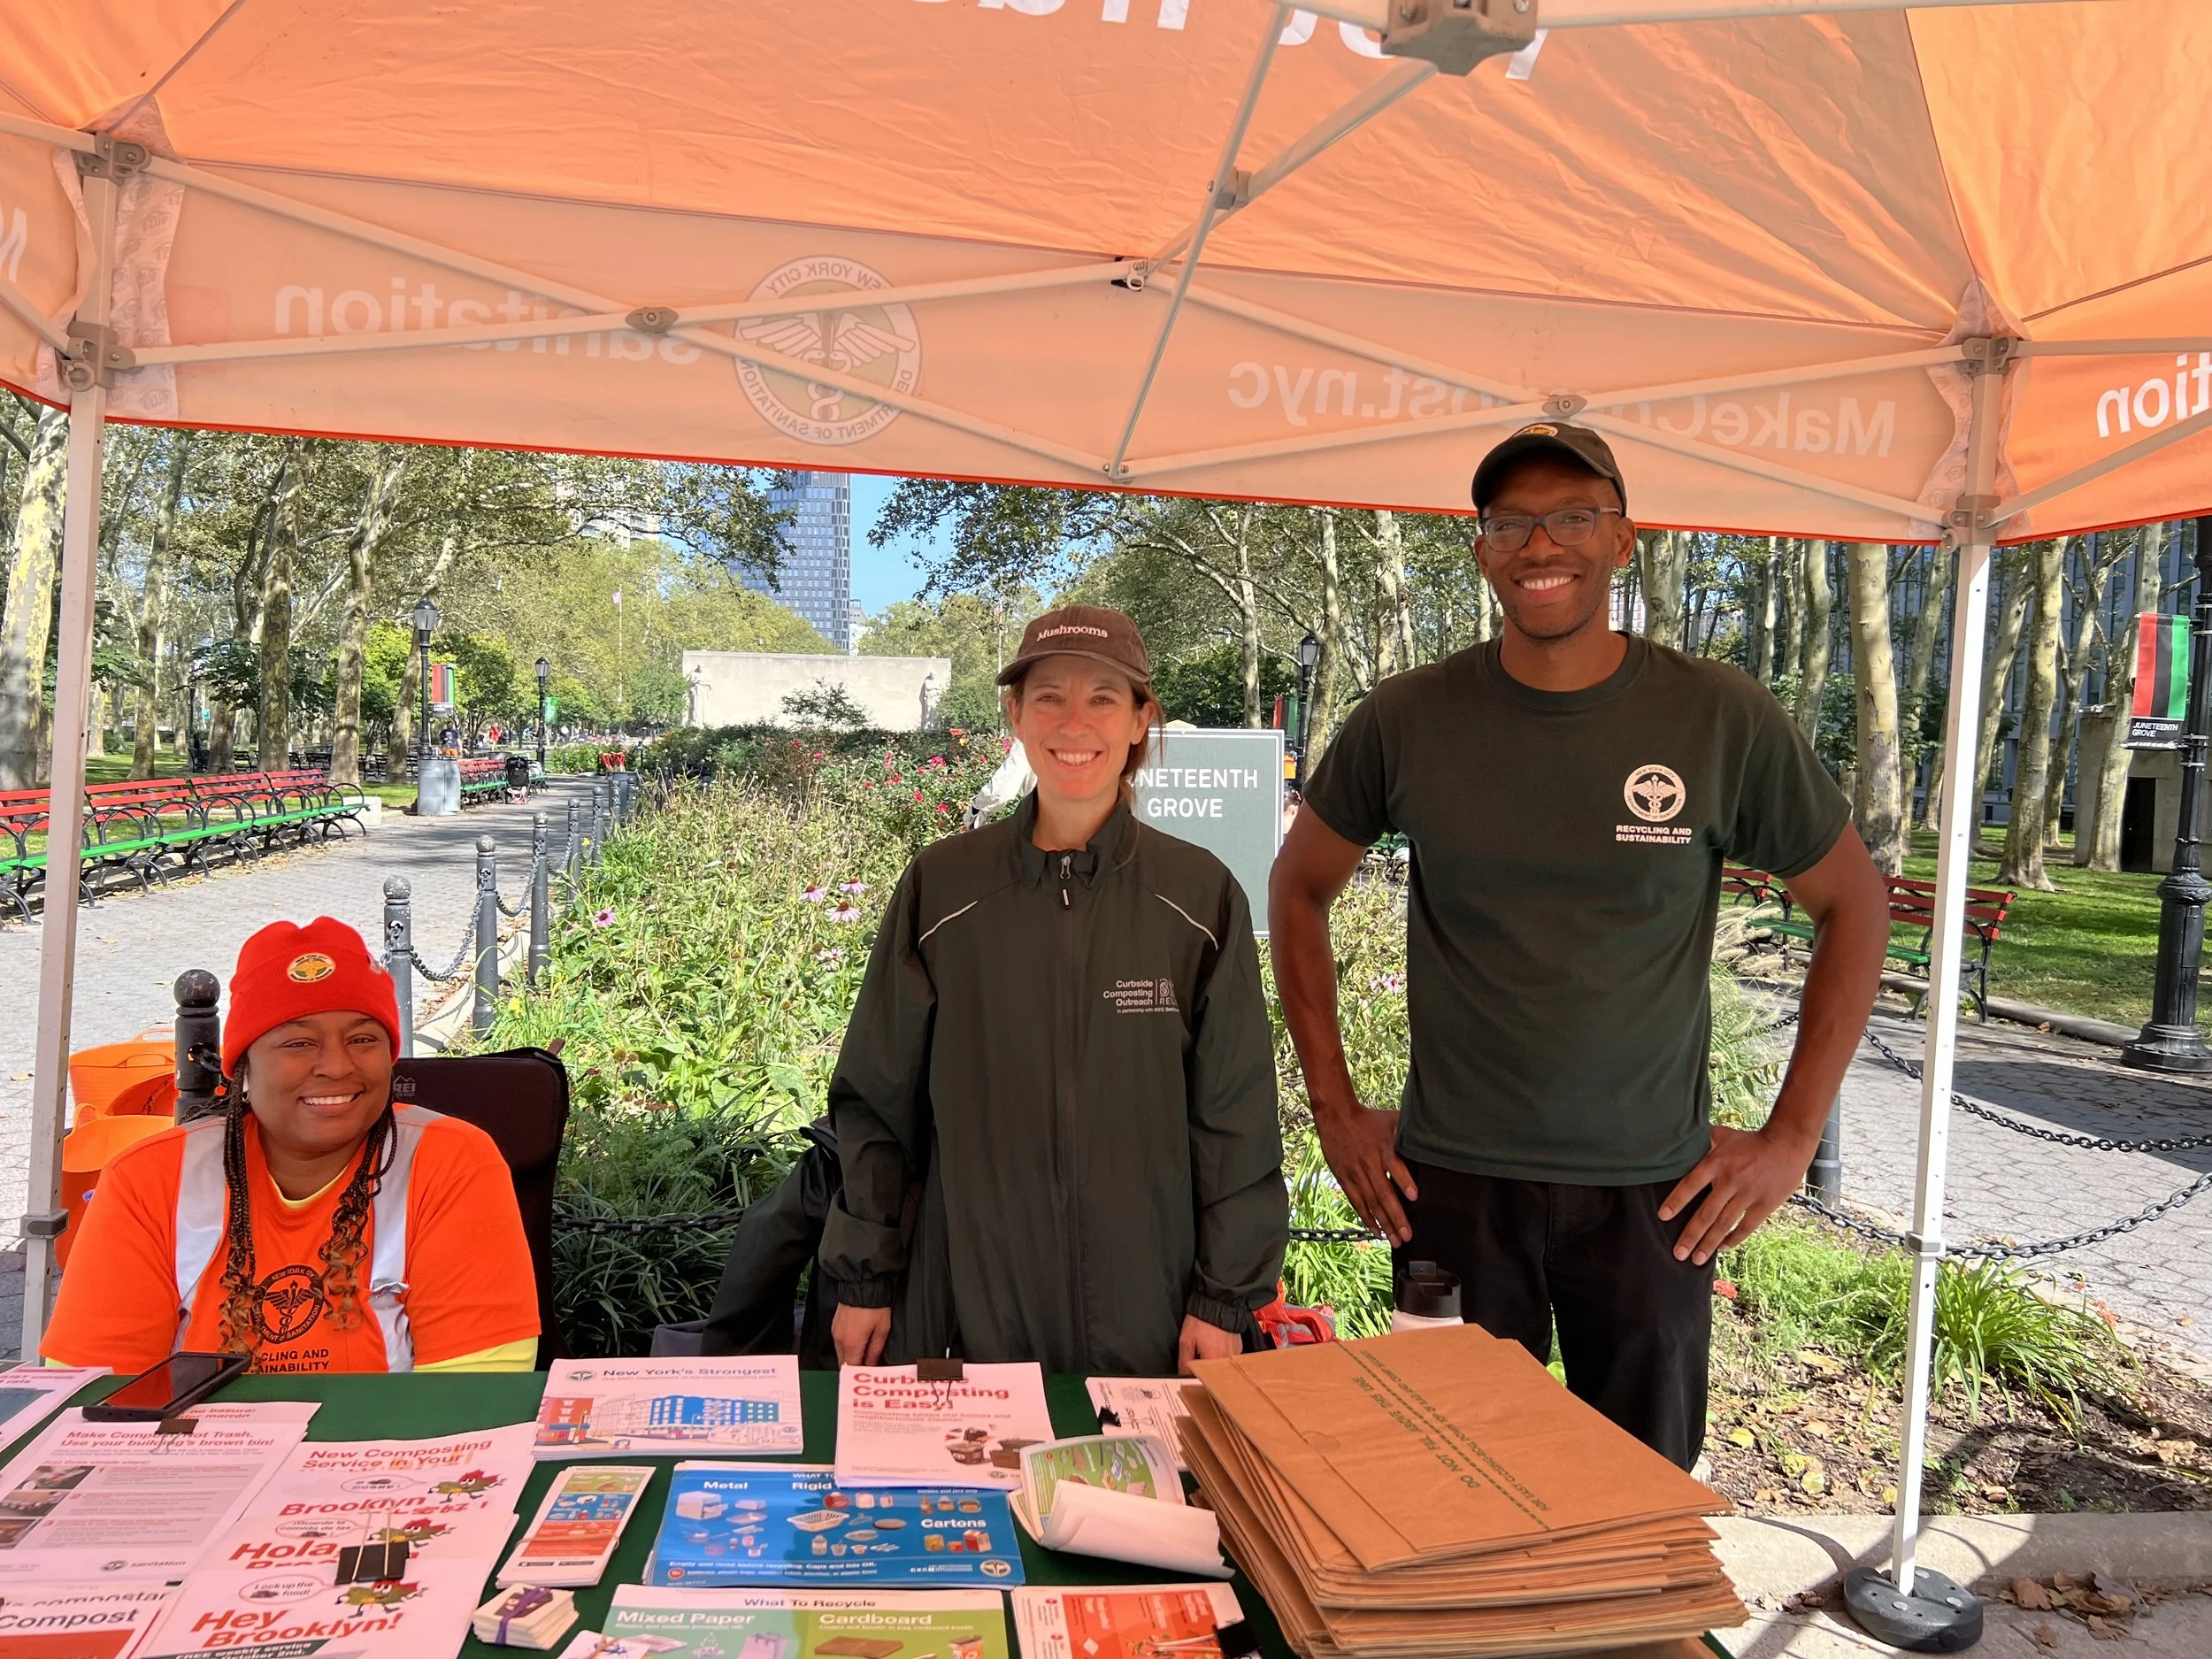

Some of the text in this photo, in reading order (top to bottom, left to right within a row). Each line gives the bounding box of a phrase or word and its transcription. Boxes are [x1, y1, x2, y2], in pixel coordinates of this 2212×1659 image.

[1037, 625, 1109, 641] Mushrooms
[2131, 729, 2156, 738] GROVE
[2132, 722, 2178, 732] JUNETEENTH
[1139, 768, 1258, 788] NETEENTH
[1147, 798, 1223, 818] GROVE
[1616, 825, 1693, 836] RECYCLING AND
[1616, 833, 1692, 844] SUSTAINABILITY
[1116, 979, 1154, 988] Curbside
[1102, 988, 1154, 999] Composting
[1116, 998, 1153, 1007] Outreach
[271, 1271, 286, 1281] NEW
[287, 1304, 320, 1340] SANITATION
[262, 1348, 329, 1362] CLING AND
[257, 1360, 330, 1373] AINABILITY
[853, 1373, 969, 1384] Curb
[853, 1386, 1010, 1399] Composting
[853, 1399, 874, 1408] is
[1353, 1376, 1480, 1489] DO NOT FILL ABOVE THIS LINE
[310, 1440, 493, 1459] New Composting
[303, 1459, 382, 1469] Service
[413, 1454, 466, 1465] Your
[703, 1481, 749, 1490] Metal
[792, 1482, 833, 1491] Rigid
[1513, 1483, 1535, 1500] EASY
[279, 1496, 427, 1517] Brooklyn
[1531, 1497, 1551, 1511] FOR
[921, 1518, 987, 1529] Cartons
[813, 1599, 876, 1608] Recycle
[0, 1609, 139, 1630] Compost
[190, 1609, 290, 1633] Hey
[618, 1611, 756, 1625] Mixed Paper
[819, 1614, 932, 1625] Cardboard
[203, 1613, 403, 1647] Brooklyn!
